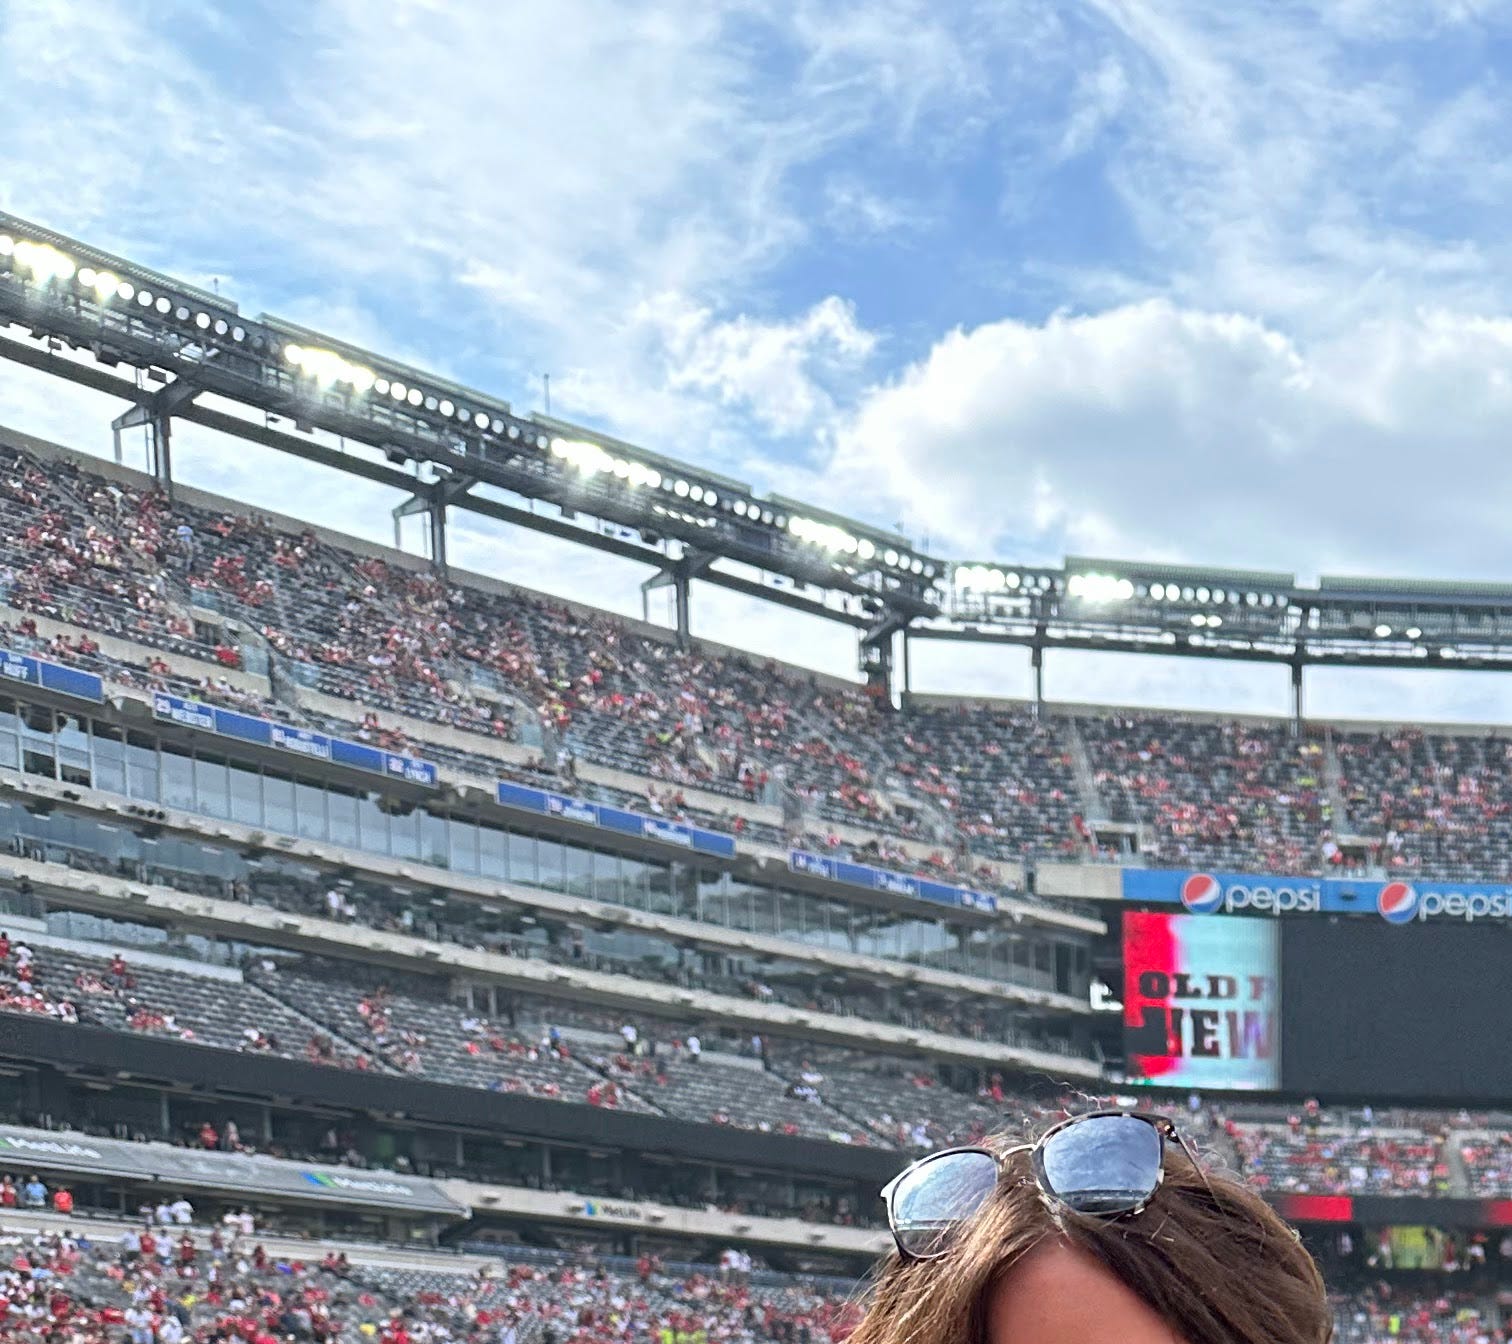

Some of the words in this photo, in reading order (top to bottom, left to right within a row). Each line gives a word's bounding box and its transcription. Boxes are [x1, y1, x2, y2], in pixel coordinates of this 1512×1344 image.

[1225, 884, 1321, 916] pepsi
[1419, 888, 1512, 921] pepsi
[1139, 971, 1238, 1000] OLD
